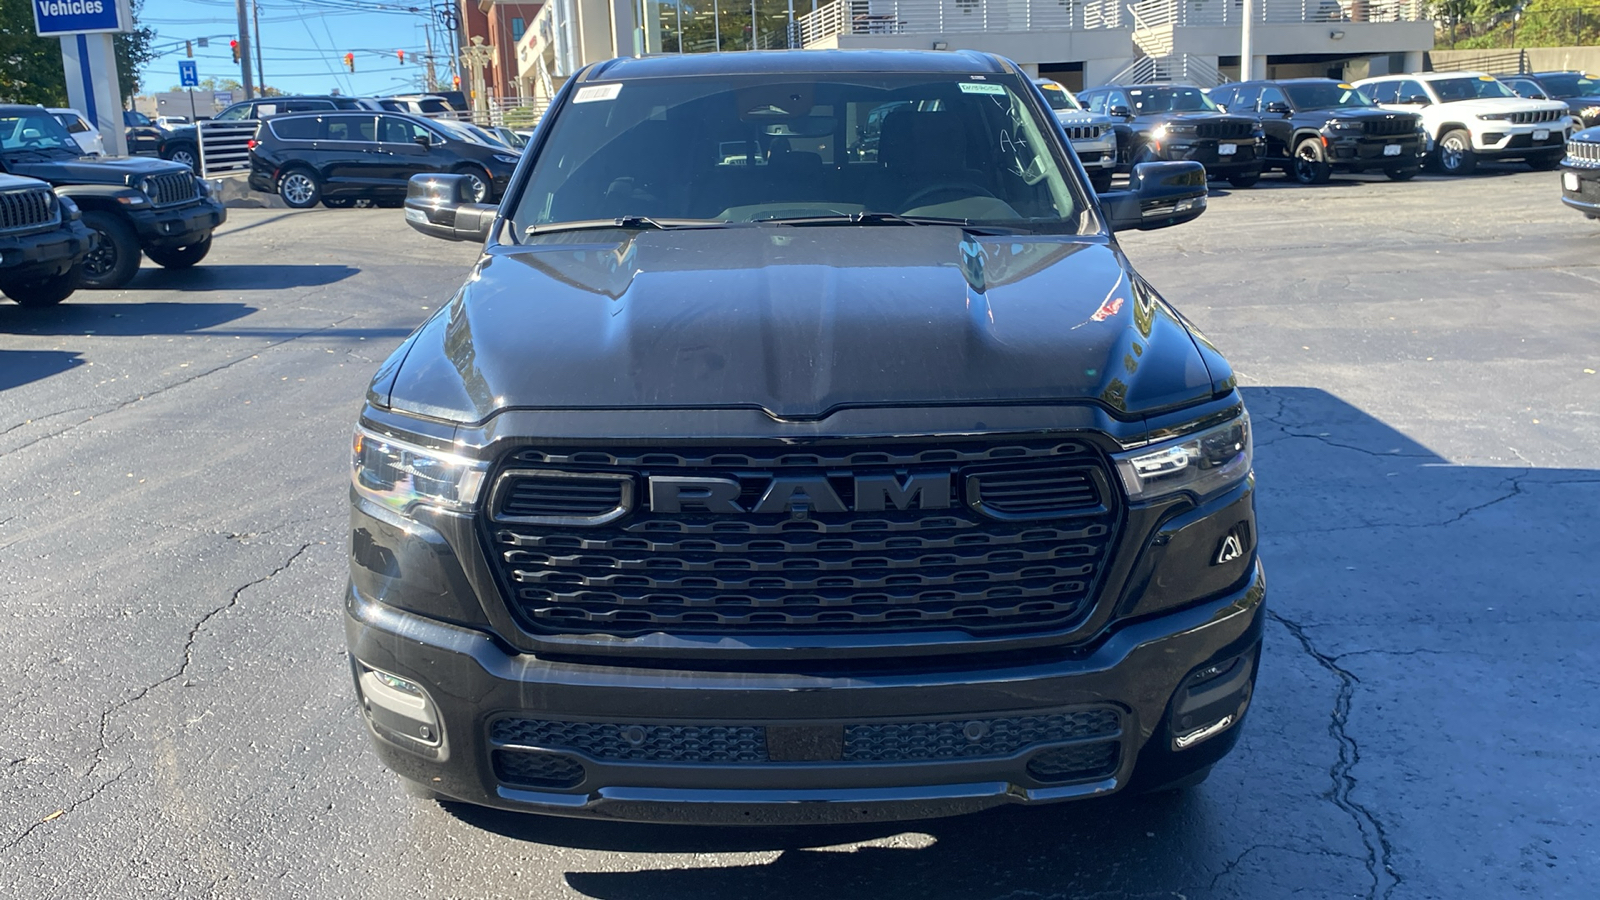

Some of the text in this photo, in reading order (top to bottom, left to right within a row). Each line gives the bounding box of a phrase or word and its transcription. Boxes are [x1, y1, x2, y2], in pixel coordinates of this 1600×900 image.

[39, 0, 103, 16] Vehicles
[183, 66, 194, 79] H
[649, 473, 951, 513] RAM
